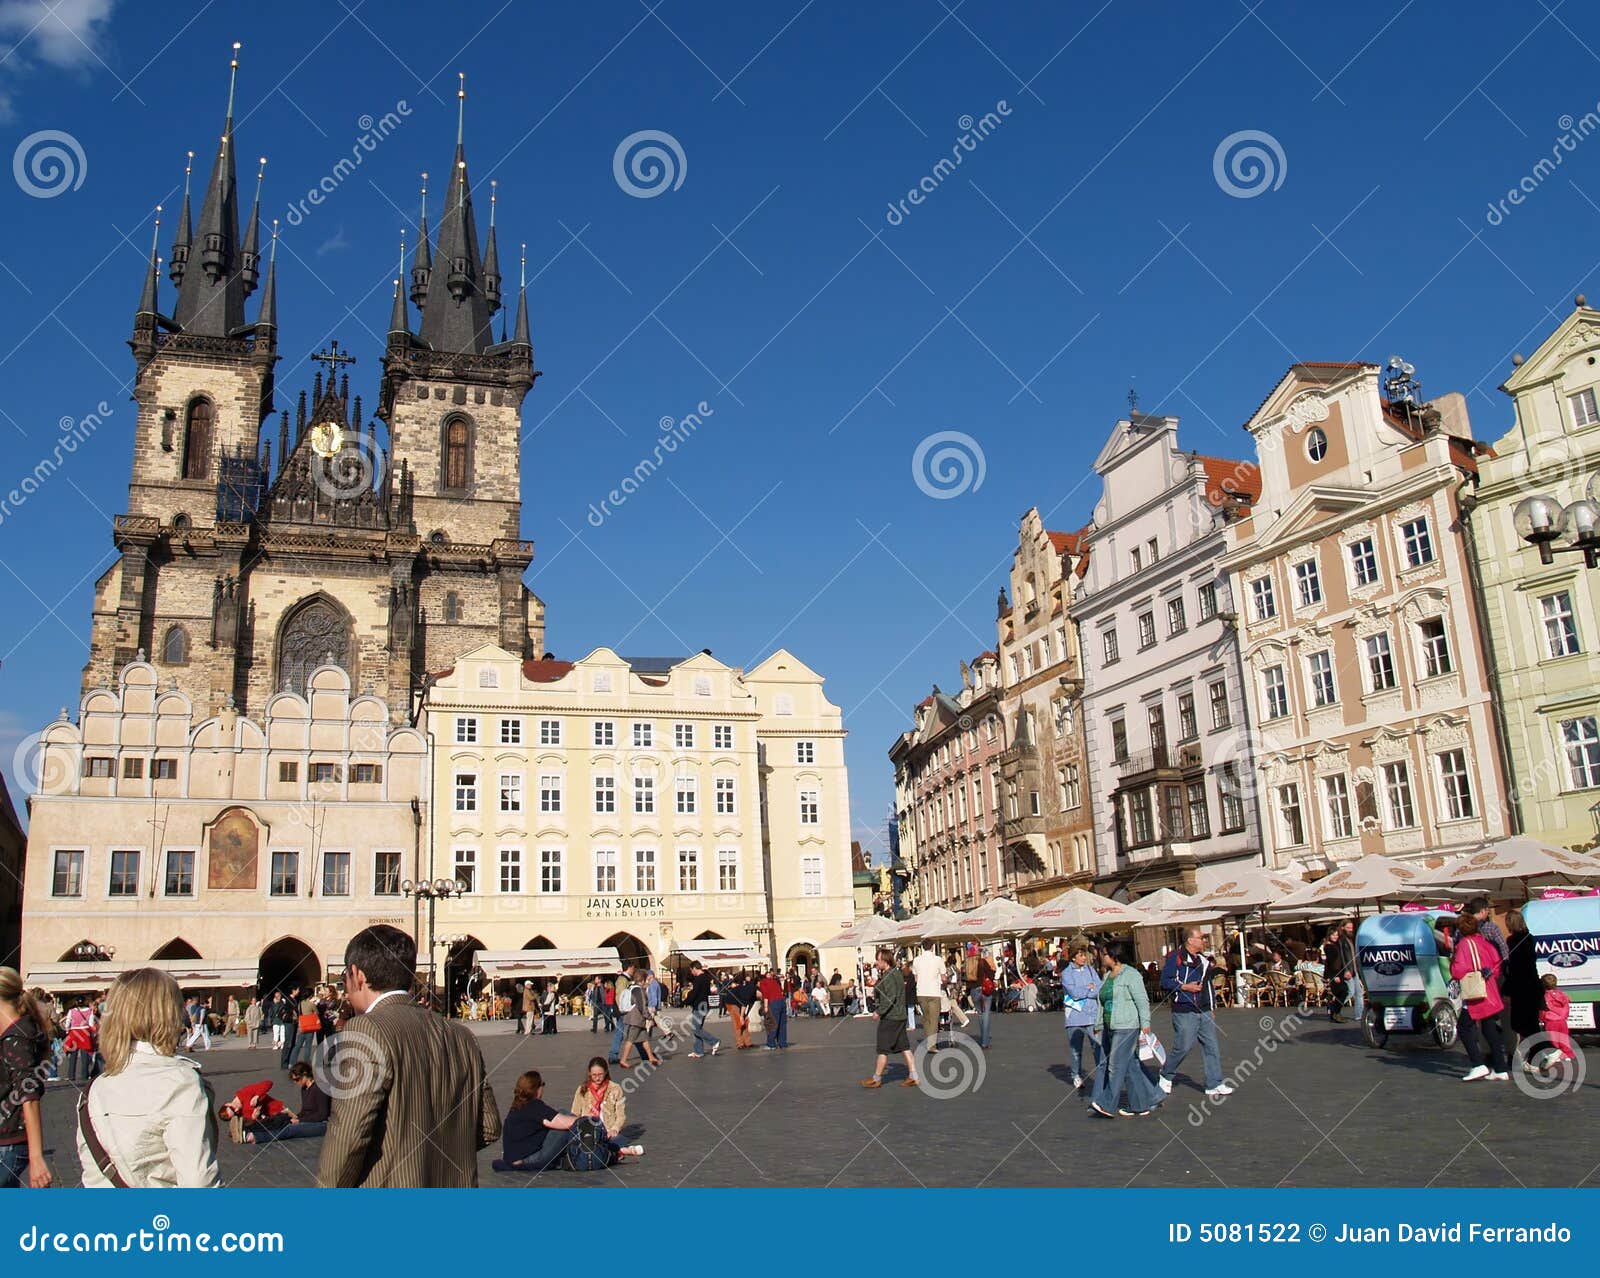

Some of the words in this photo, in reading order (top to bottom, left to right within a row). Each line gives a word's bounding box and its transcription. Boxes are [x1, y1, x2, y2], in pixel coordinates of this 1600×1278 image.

[587, 898, 610, 909] JAN
[615, 897, 664, 909] SAUDEK
[586, 909, 665, 918] exhibition
[1534, 937, 1599, 954] MATTONI
[1362, 949, 1413, 963] MATTONI
